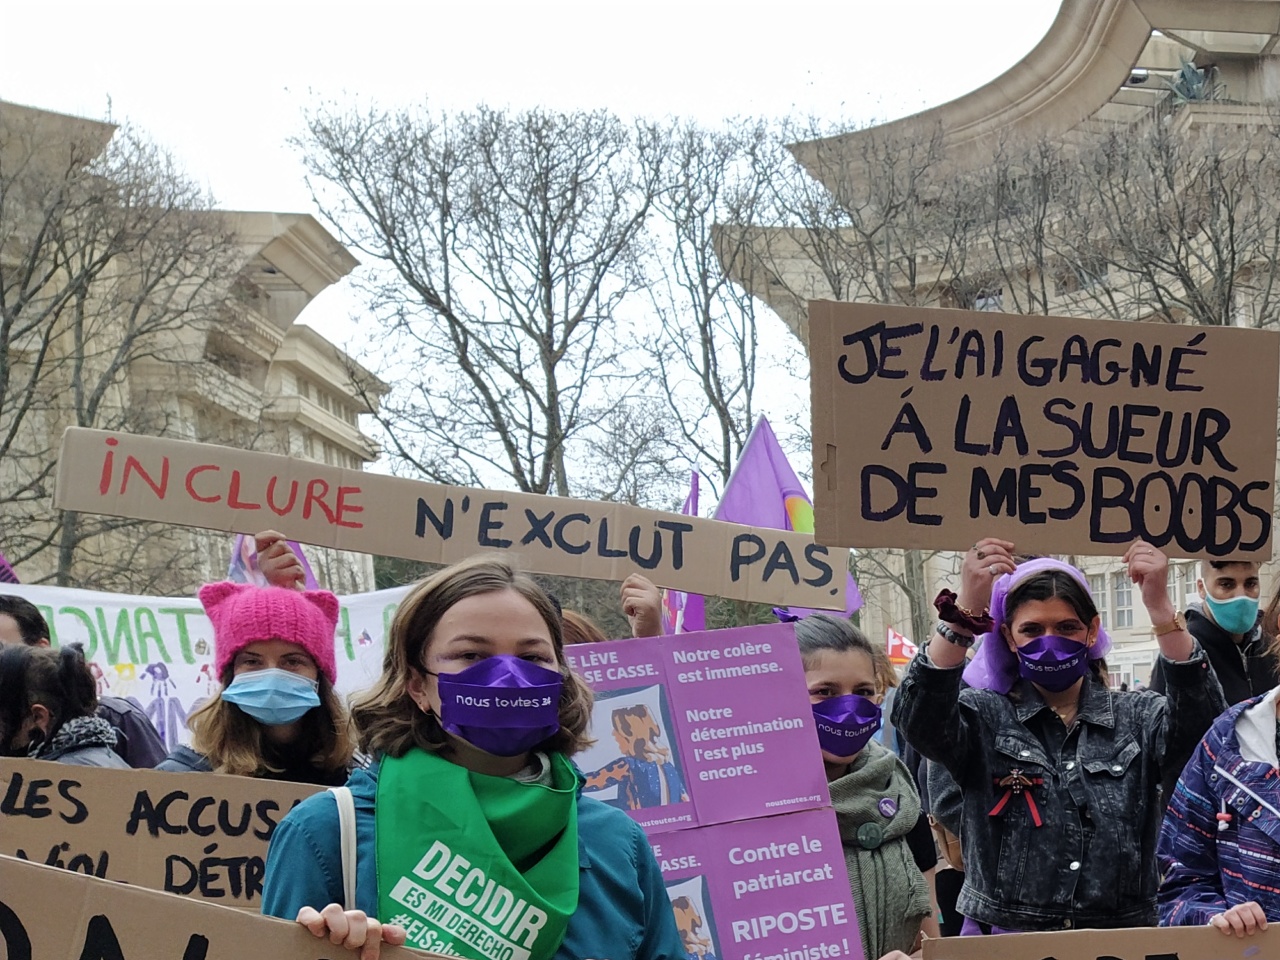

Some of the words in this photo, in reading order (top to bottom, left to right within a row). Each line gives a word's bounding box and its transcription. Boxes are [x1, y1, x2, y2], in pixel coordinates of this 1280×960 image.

[838, 320, 923, 384] JE
[919, 325, 1003, 380] L'AI
[1017, 333, 1207, 392] GAGNÉ
[954, 394, 1028, 458] LA
[1037, 398, 1238, 472] SUEUR
[860, 462, 947, 525] DE
[969, 461, 1085, 525] MES
[1089, 467, 1270, 556] BOOBS
[414, 494, 694, 571] N'EXCLUT
[731, 533, 838, 595] PAS.
[580, 651, 619, 668] LÈVE
[673, 649, 721, 664] Notre
[723, 642, 772, 658] colère
[584, 669, 603, 683] SE
[606, 663, 659, 681] CASSE.
[677, 668, 703, 684] est
[705, 662, 783, 681] immense.
[456, 694, 490, 708] nous
[495, 696, 539, 708] toutes
[686, 706, 733, 722] Notre
[690, 716, 804, 742] détermination
[818, 723, 842, 736] nous
[694, 745, 729, 762] l'est
[732, 740, 765, 760] plus
[699, 764, 758, 781] encore.
[1, 772, 88, 825] LES
[126, 790, 300, 841] ACCUS
[765, 794, 821, 808] noustoutes.org
[728, 842, 800, 865] Contre
[801, 835, 822, 854] le
[412, 839, 548, 950] DECIDIR
[732, 863, 833, 899] patriarcat
[402, 886, 426, 909] ES
[423, 899, 451, 923] MI
[388, 913, 466, 958] #ElSal
[731, 903, 848, 943] RIPOSTE
